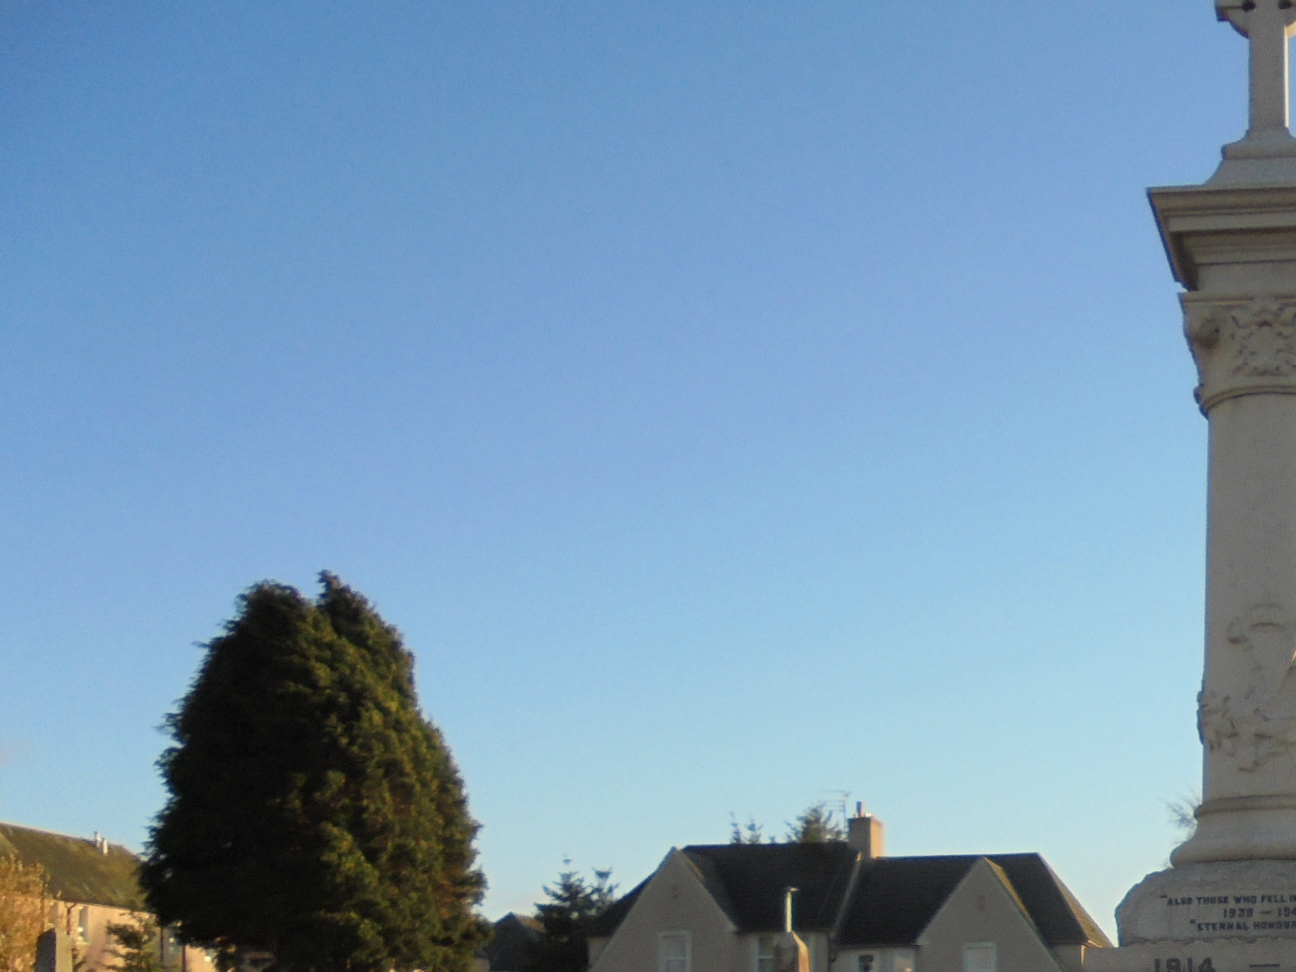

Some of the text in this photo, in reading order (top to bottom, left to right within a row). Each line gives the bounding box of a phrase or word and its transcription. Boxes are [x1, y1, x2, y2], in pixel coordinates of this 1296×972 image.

[1196, 896, 1229, 905] THOSE
[1233, 895, 1257, 905] WHO
[1261, 894, 1286, 903] FELL
